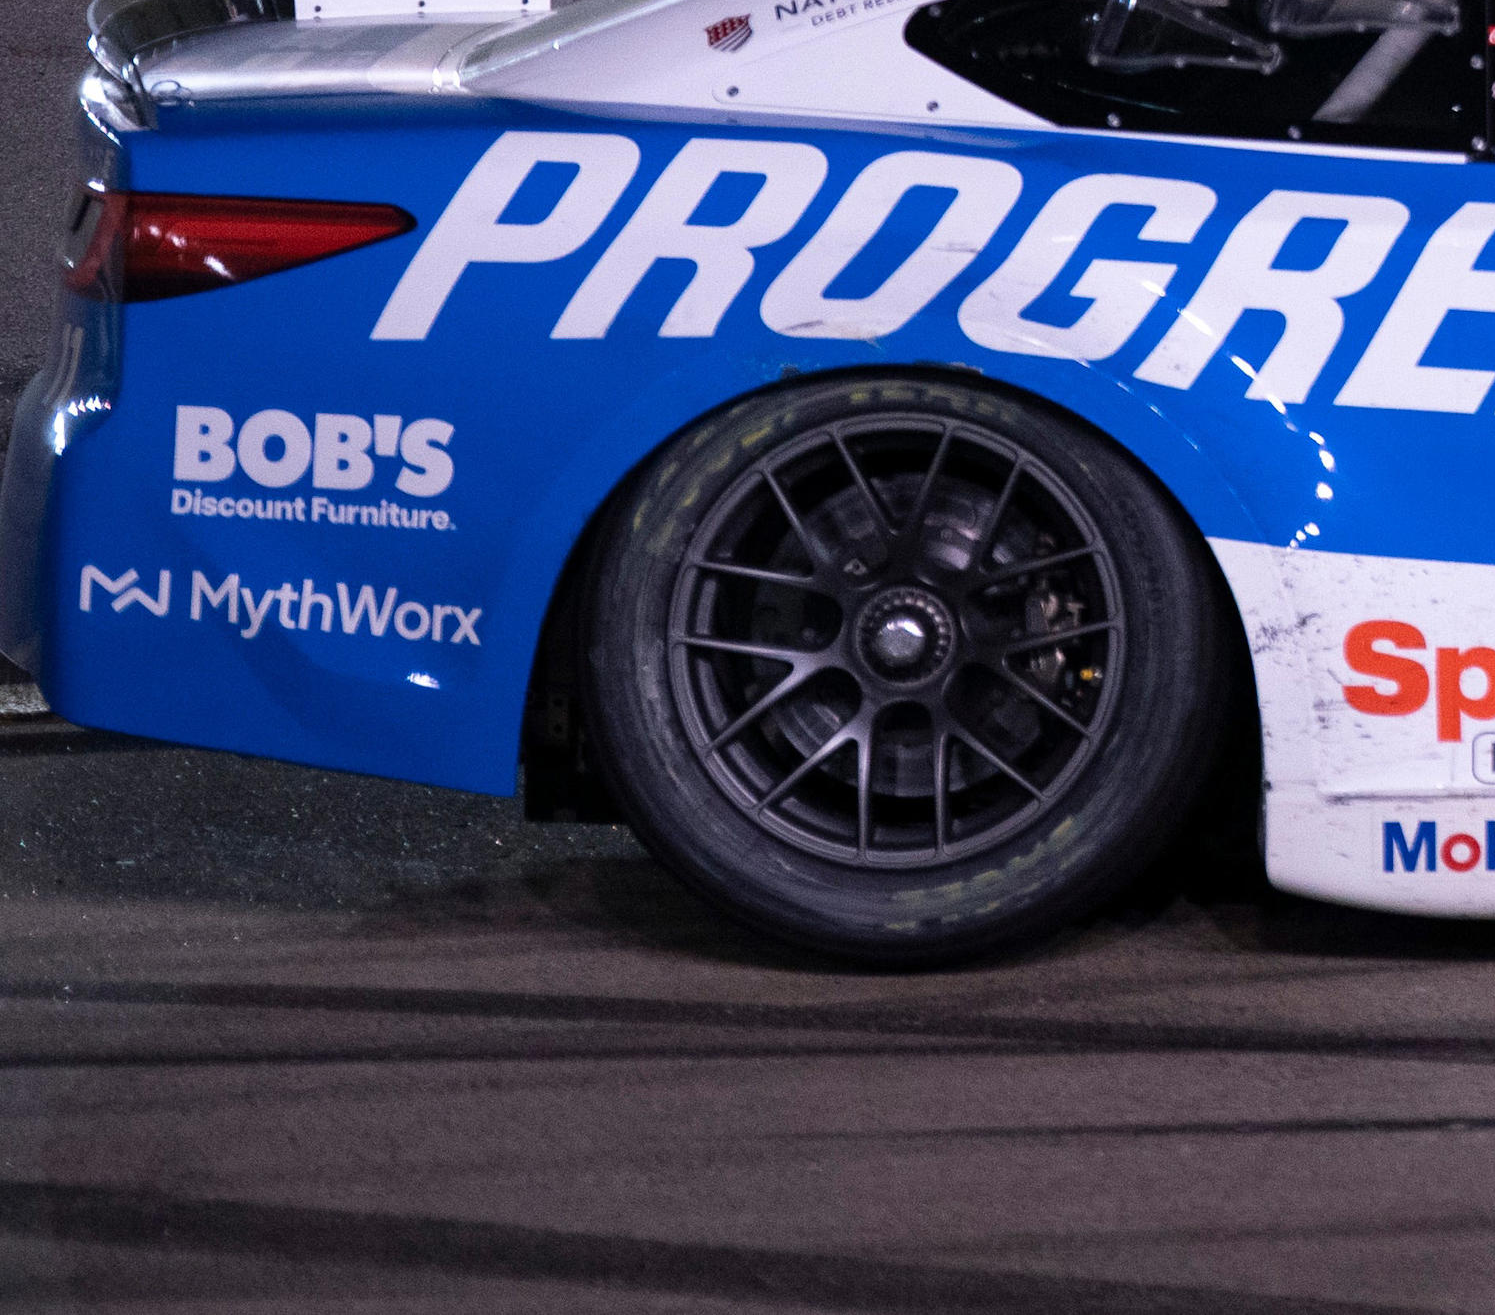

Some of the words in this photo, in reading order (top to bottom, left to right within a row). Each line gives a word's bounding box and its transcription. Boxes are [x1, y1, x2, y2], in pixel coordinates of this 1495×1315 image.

[811, 3, 857, 27] DEBT
[173, 404, 455, 498] BOB'S
[170, 487, 306, 522] Discount
[190, 569, 482, 646] MythWorx
